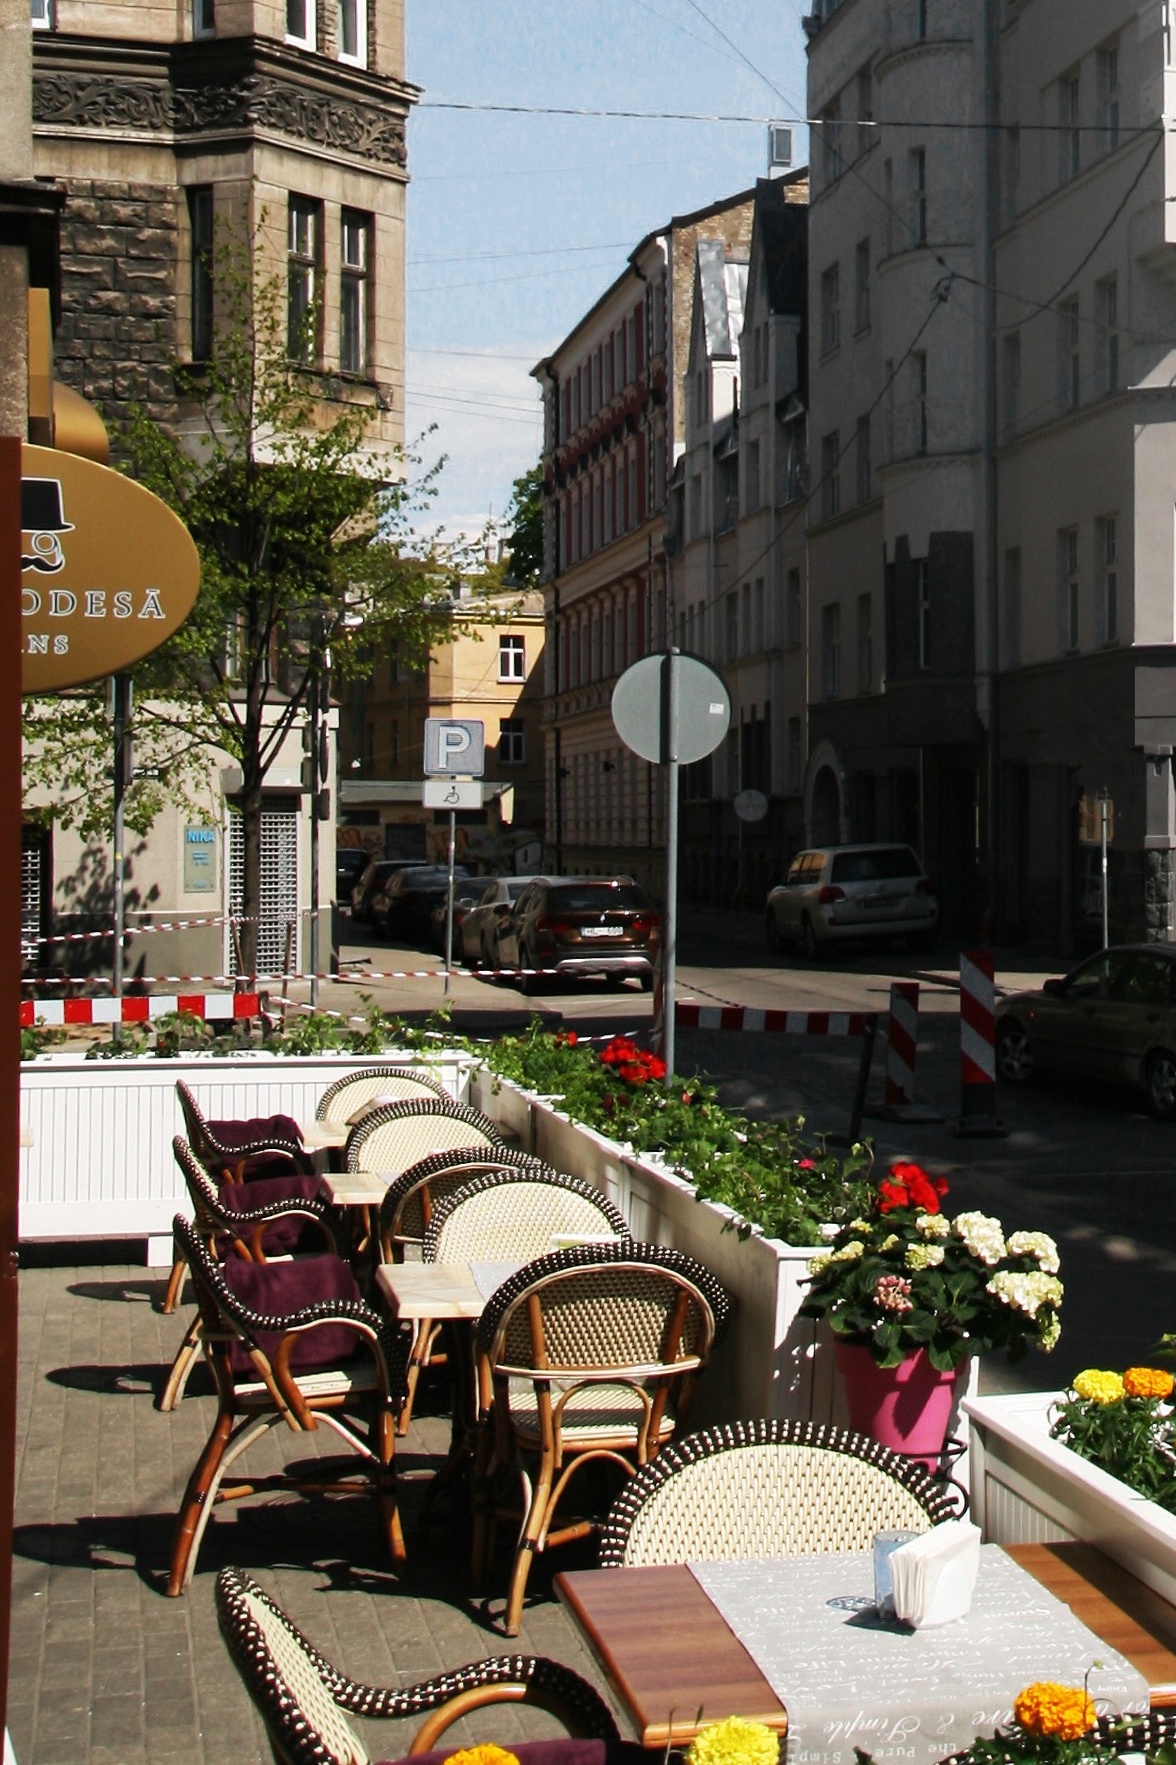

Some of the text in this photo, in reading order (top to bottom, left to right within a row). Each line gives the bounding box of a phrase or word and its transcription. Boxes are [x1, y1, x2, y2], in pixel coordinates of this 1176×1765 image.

[439, 725, 472, 769] P
[823, 1709, 921, 1745] Simple
[874, 1746, 916, 1758] Pure
[928, 1743, 957, 1755] the
